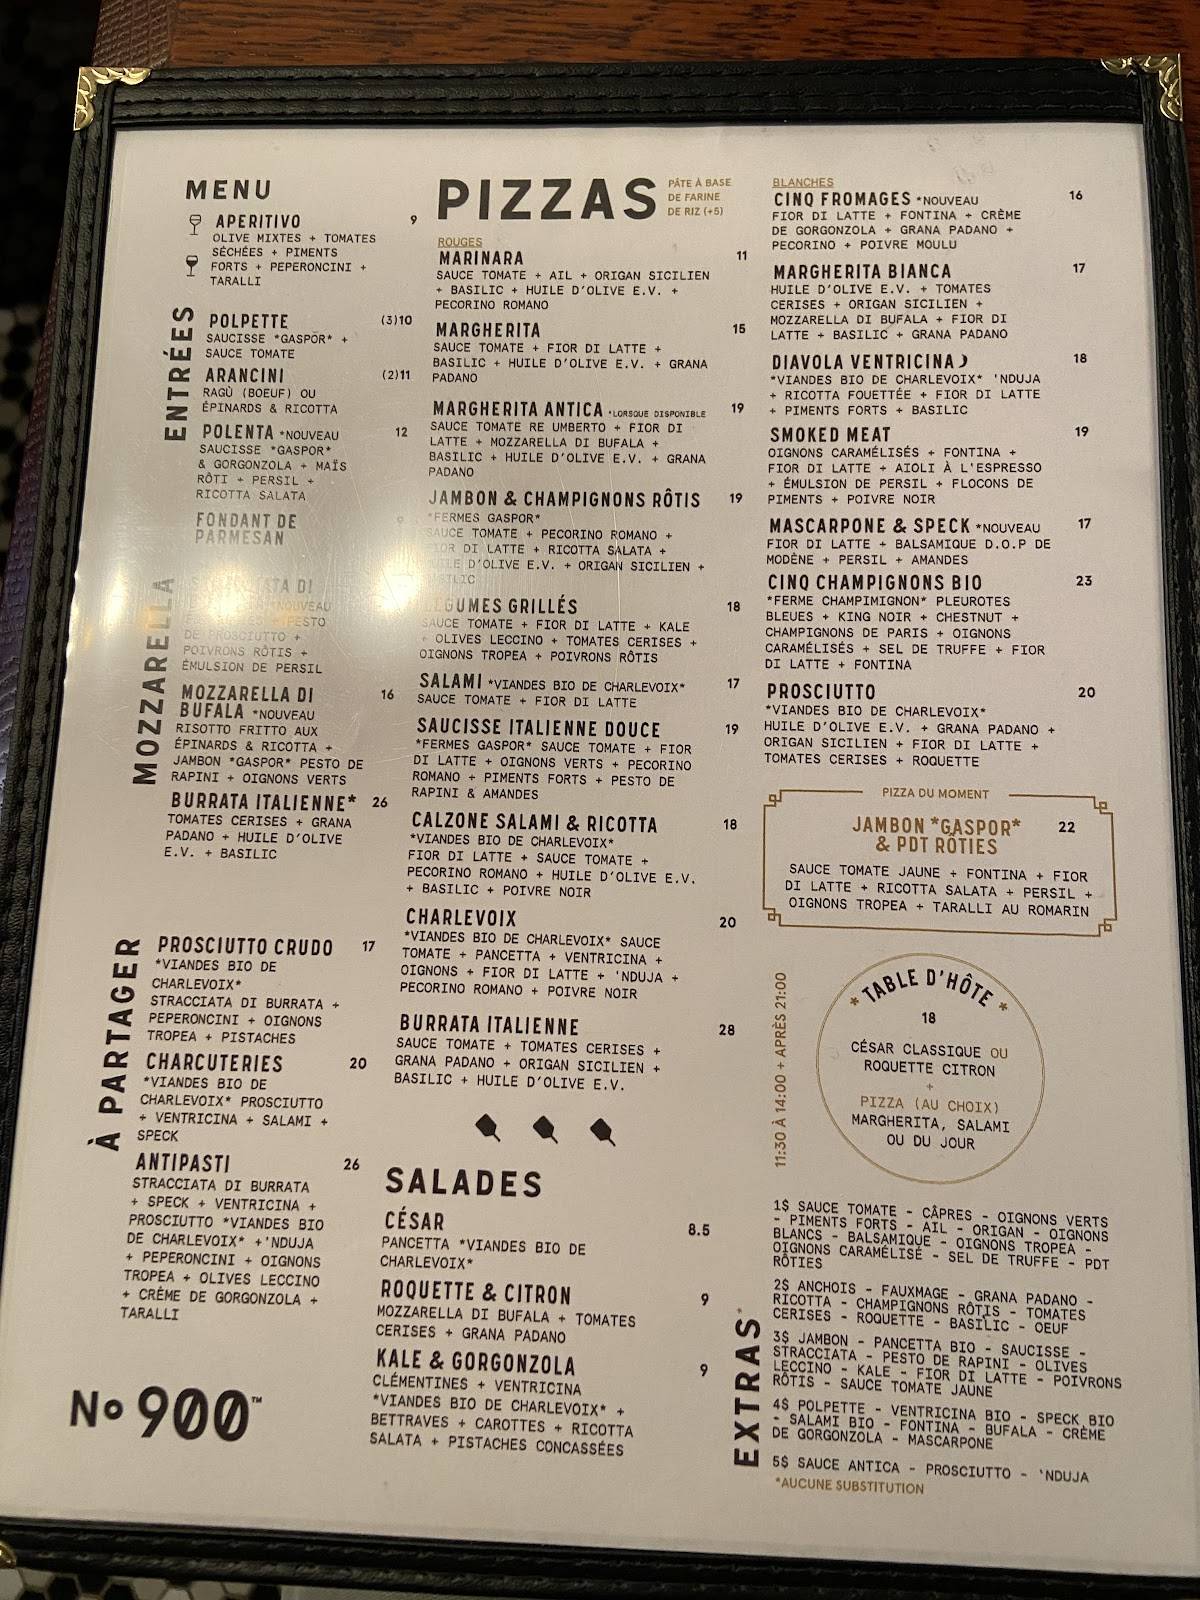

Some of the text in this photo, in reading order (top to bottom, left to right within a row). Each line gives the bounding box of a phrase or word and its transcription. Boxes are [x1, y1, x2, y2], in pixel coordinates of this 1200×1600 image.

[186, 179, 270, 200] MENU
[668, 177, 732, 188] PÂTE À BASE
[772, 177, 835, 188] BLANCHES
[438, 177, 656, 220] PIZZAS
[668, 192, 720, 202] DE FARINE
[774, 191, 911, 208] CINQ FROMAGES
[1069, 190, 1083, 200] 16
[667, 206, 723, 216] DE RIZ (+5)
[216, 214, 300, 229] APERITIVO
[410, 215, 418, 225] 9
[438, 237, 483, 248] ROUGES
[439, 250, 523, 265] MARINARA
[736, 250, 747, 261] 11
[774, 263, 951, 280] MARGHERITA BIANCA
[1073, 263, 1086, 273] 17
[210, 276, 261, 286] TARALLI
[435, 299, 549, 310] PECORINO ROMANO
[209, 313, 288, 329] POLPETTE
[381, 314, 412, 326] (3)10
[436, 322, 540, 338] MARGHERITA
[733, 323, 746, 334] 15
[772, 353, 954, 370] DIAVOLA VENTRICINA
[1073, 353, 1087, 364] 18
[163, 307, 194, 441] ENTRÉES
[205, 367, 283, 383] ARANCINI
[382, 369, 410, 380] (2)11
[840, 374, 864, 385] BIO
[872, 374, 887, 385] DE
[203, 385, 316, 399] RAGÙ (BOEUF) OU
[433, 400, 603, 418] MARGHERITA ANTICA
[731, 402, 744, 414] 19
[203, 424, 274, 440] POLENTA
[395, 426, 408, 437] 12
[770, 426, 891, 443] SMOKED MEAT
[1075, 426, 1089, 437] 19
[429, 488, 700, 508] JAMBON & CHAMPIGNONS RÔTIS
[730, 492, 743, 504] 19
[196, 512, 297, 529] FONDANT DE
[770, 517, 970, 534] MASCARPONE & SPECK
[1078, 518, 1091, 529] 17
[195, 529, 284, 546] PARMESAN
[768, 574, 982, 591] CINQ CHAMPIGNONS BIO
[1076, 575, 1092, 586] 23
[508, 594, 577, 615] GRILLÉS
[727, 601, 741, 612] 18
[936, 596, 1010, 607] PLEUROTES
[132, 577, 175, 785] MOZZARELLA
[419, 672, 482, 689] SALAMI
[727, 678, 740, 689] 17
[181, 684, 313, 703] MOZZARELLA DI
[381, 689, 394, 700] 16
[767, 683, 875, 700] PROSCIUTTO
[1078, 686, 1096, 698] 20
[180, 701, 244, 719] BUFALA
[417, 717, 660, 738] SAUCISSE ITALIENNE DOUCE
[725, 723, 739, 735] 19
[171, 792, 248, 810] BURRATA
[882, 787, 990, 800] PIZZA DU MOMENT
[372, 796, 388, 808] 26
[412, 811, 657, 833] CALZONE SALAMI & RICOTTA
[723, 818, 737, 830] 18
[852, 816, 924, 834] JAMBON
[1058, 821, 1075, 833] 22
[406, 907, 516, 927] CHARLEVOIX
[719, 916, 736, 928] 20
[158, 936, 333, 956] PROSCIUTTO CRUDO
[362, 940, 376, 952] 17
[861, 968, 994, 1007] TABLE D'HÔTE
[400, 1013, 579, 1036] BURRATA ITALIENNE
[922, 1012, 936, 1024] 18
[719, 1024, 735, 1036] 28
[87, 939, 141, 1152] À PARTAGER
[851, 1038, 1008, 1059] CÉSAR CLASSIQUE OU
[146, 1052, 283, 1073] CHARCUTERIES
[349, 1057, 367, 1070] 20
[772, 972, 787, 1168] 11:30 À 14:00 + APRÈS 21:00
[864, 1059, 995, 1077] ROQUETTE CITRON
[135, 1152, 230, 1173] ANTIPASTI
[343, 1158, 360, 1171] 26
[132, 1176, 310, 1193] STRACCIATA DI BURRATA
[385, 1167, 541, 1198] SALADES
[385, 1206, 444, 1231] CÉSAR
[688, 1223, 710, 1237] 8.5
[381, 1279, 571, 1306] ROQUETTE & CITRON
[701, 1293, 709, 1306] 9
[377, 1348, 575, 1376] KALE & GORGONZOLA
[700, 1363, 708, 1377] 9
[836, 1480, 924, 1495] SUBSTITUTION
